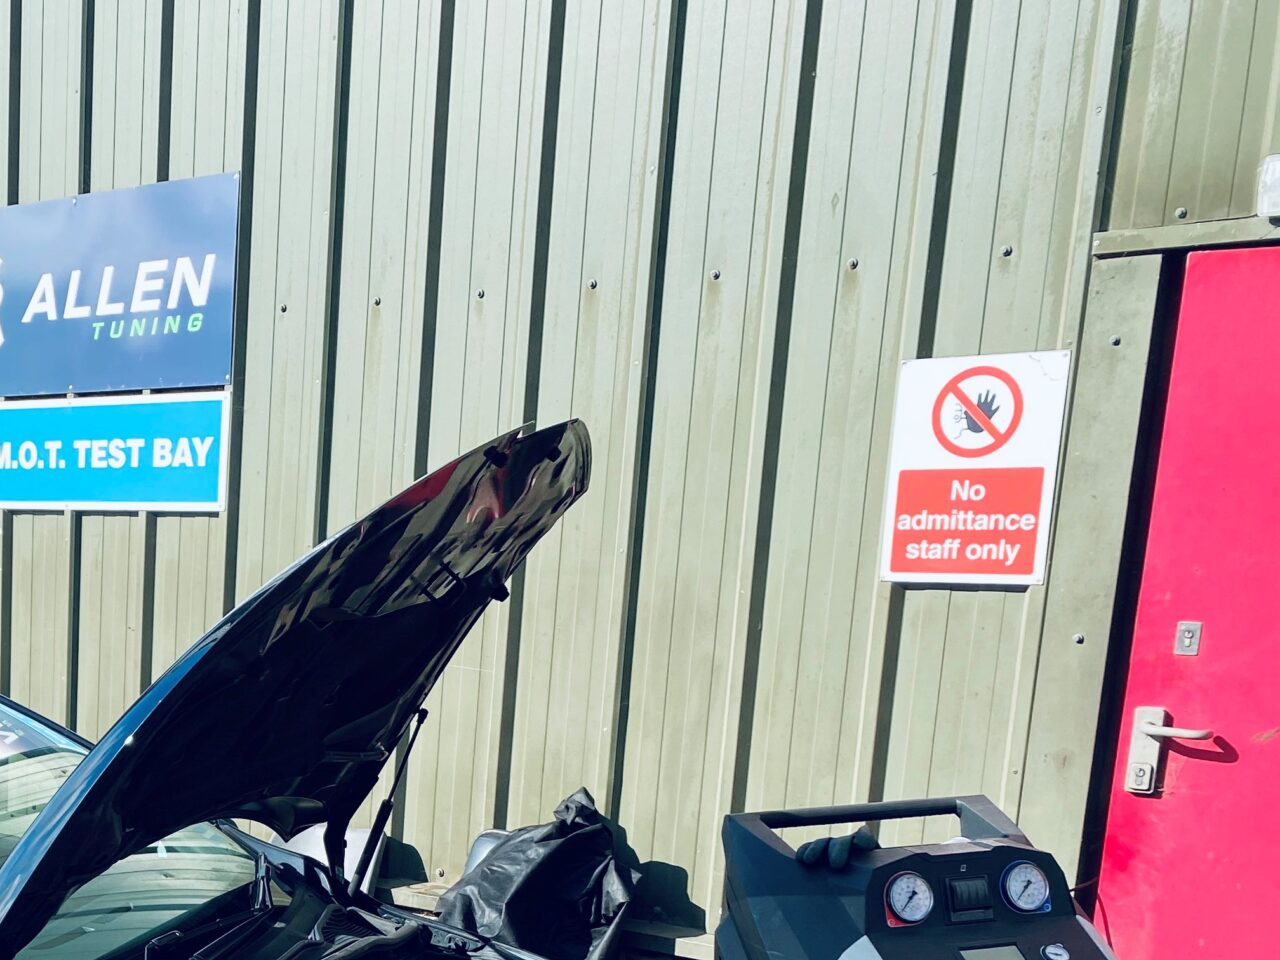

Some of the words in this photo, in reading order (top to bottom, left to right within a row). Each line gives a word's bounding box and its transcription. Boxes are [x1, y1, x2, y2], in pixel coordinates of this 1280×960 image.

[21, 253, 216, 323] ALLEN
[92, 312, 204, 340] TUNING
[73, 438, 145, 468] TEST
[152, 437, 214, 467] BAY
[950, 479, 986, 501] No
[896, 509, 1036, 531] admittance
[905, 538, 961, 560] staff
[965, 538, 1021, 566] only
